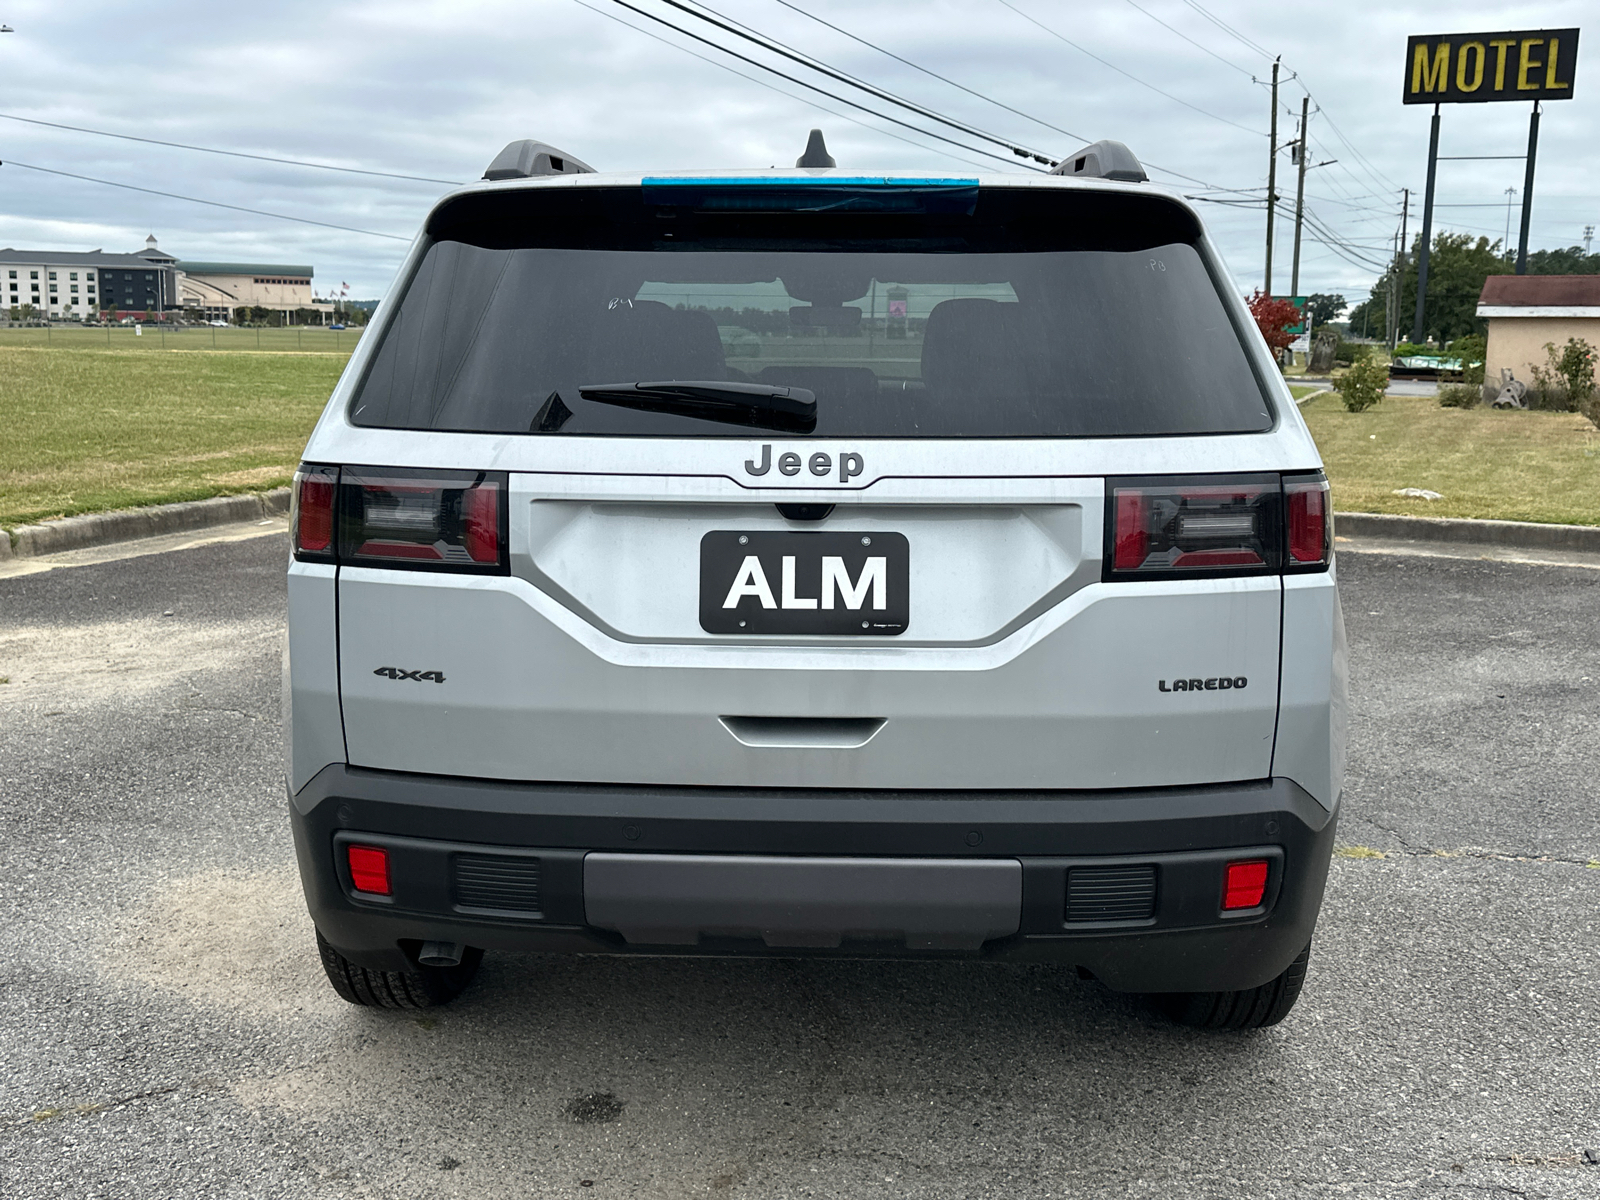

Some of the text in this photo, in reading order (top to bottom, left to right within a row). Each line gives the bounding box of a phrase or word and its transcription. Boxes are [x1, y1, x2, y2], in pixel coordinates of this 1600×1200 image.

[1411, 38, 1569, 94] MOTEL
[744, 444, 865, 483] Jeep
[721, 555, 887, 610] ALM
[1158, 676, 1248, 693] LAREDO
